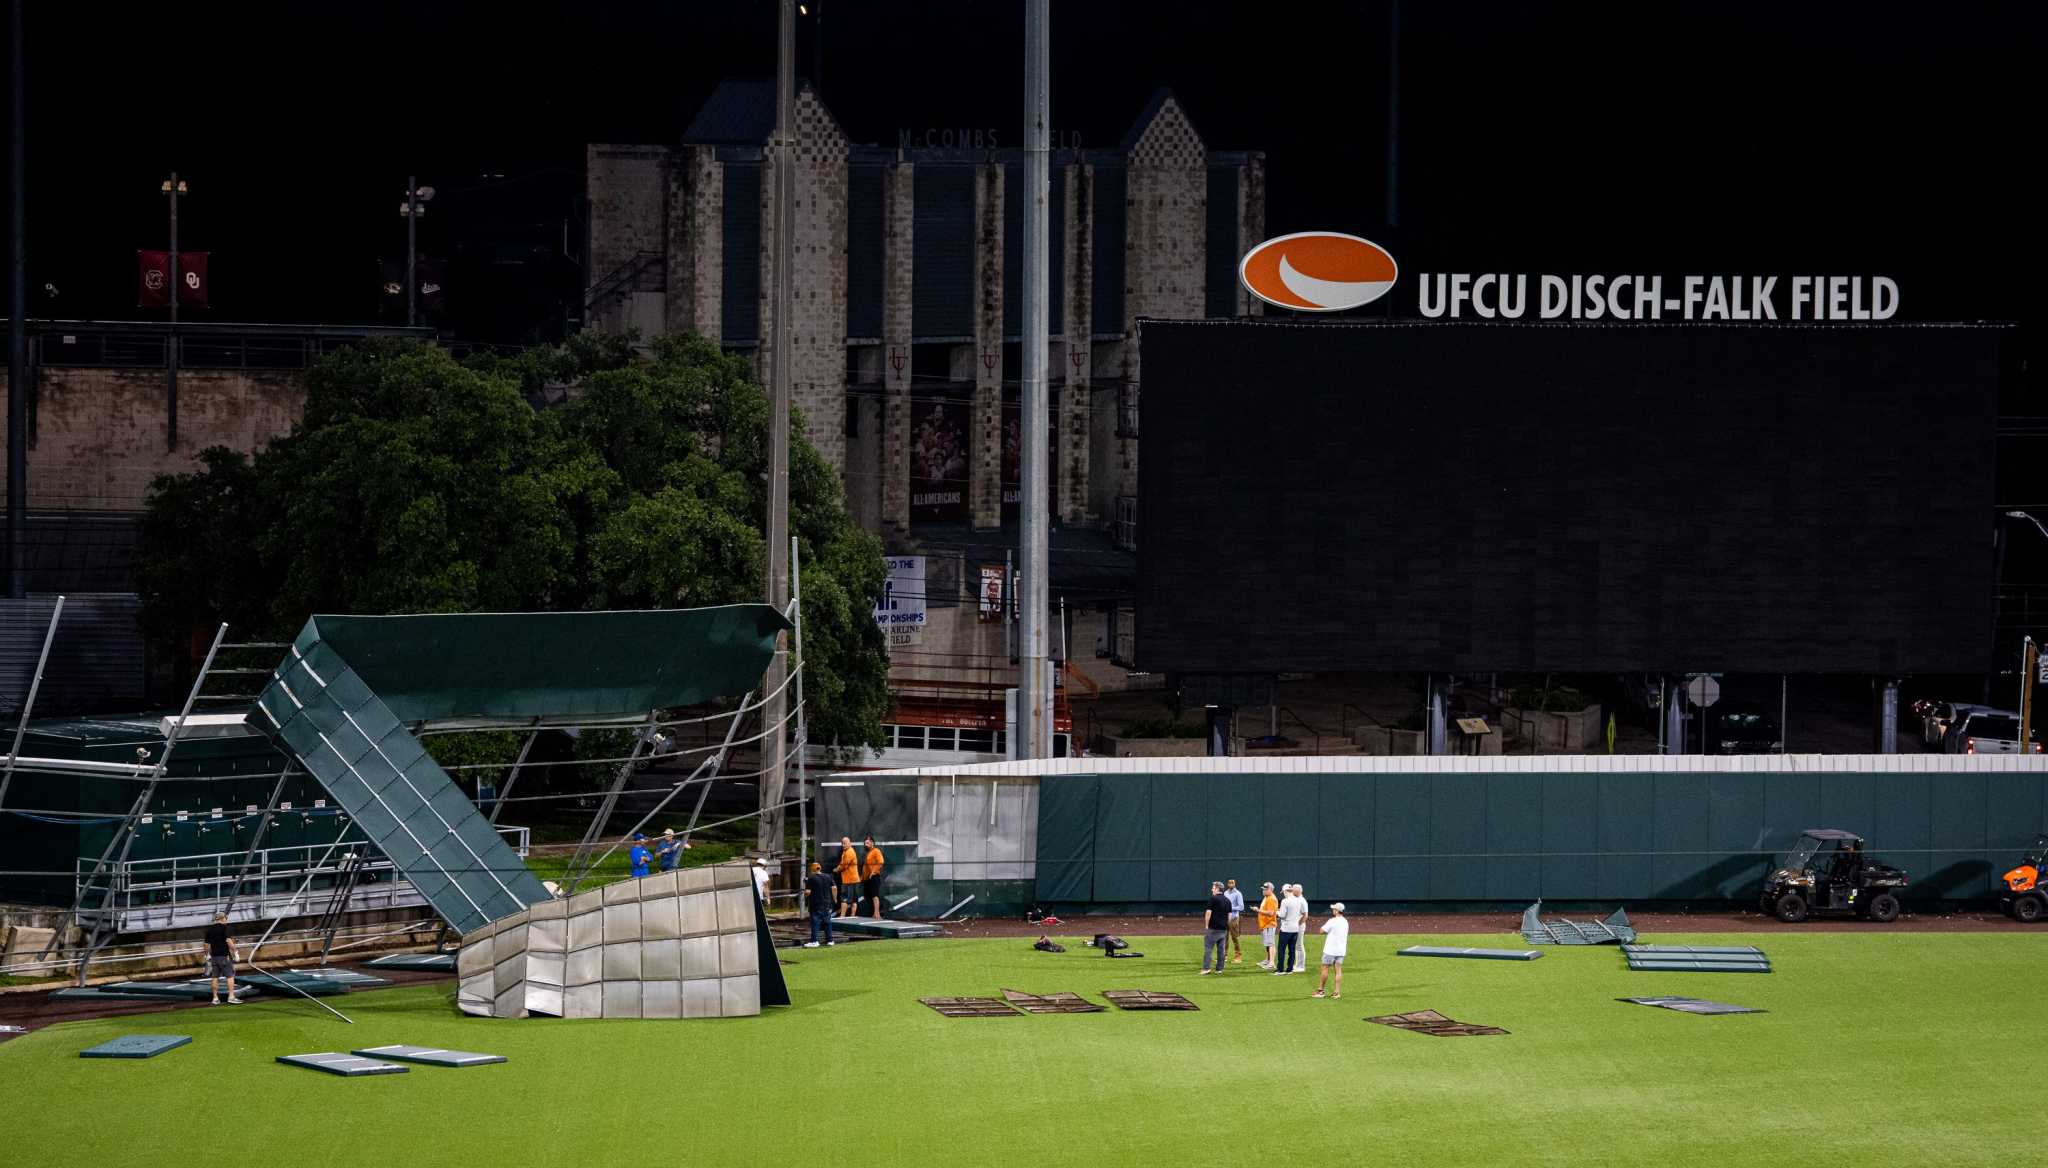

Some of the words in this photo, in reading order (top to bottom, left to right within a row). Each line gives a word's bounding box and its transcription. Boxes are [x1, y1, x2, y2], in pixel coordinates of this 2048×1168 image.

[1049, 128, 1083, 150] ELD
[1418, 272, 1527, 319] UFCU
[1540, 274, 1779, 321] DISCH-FALK
[1791, 275, 1900, 321] FIELD
[899, 559, 914, 569] THE
